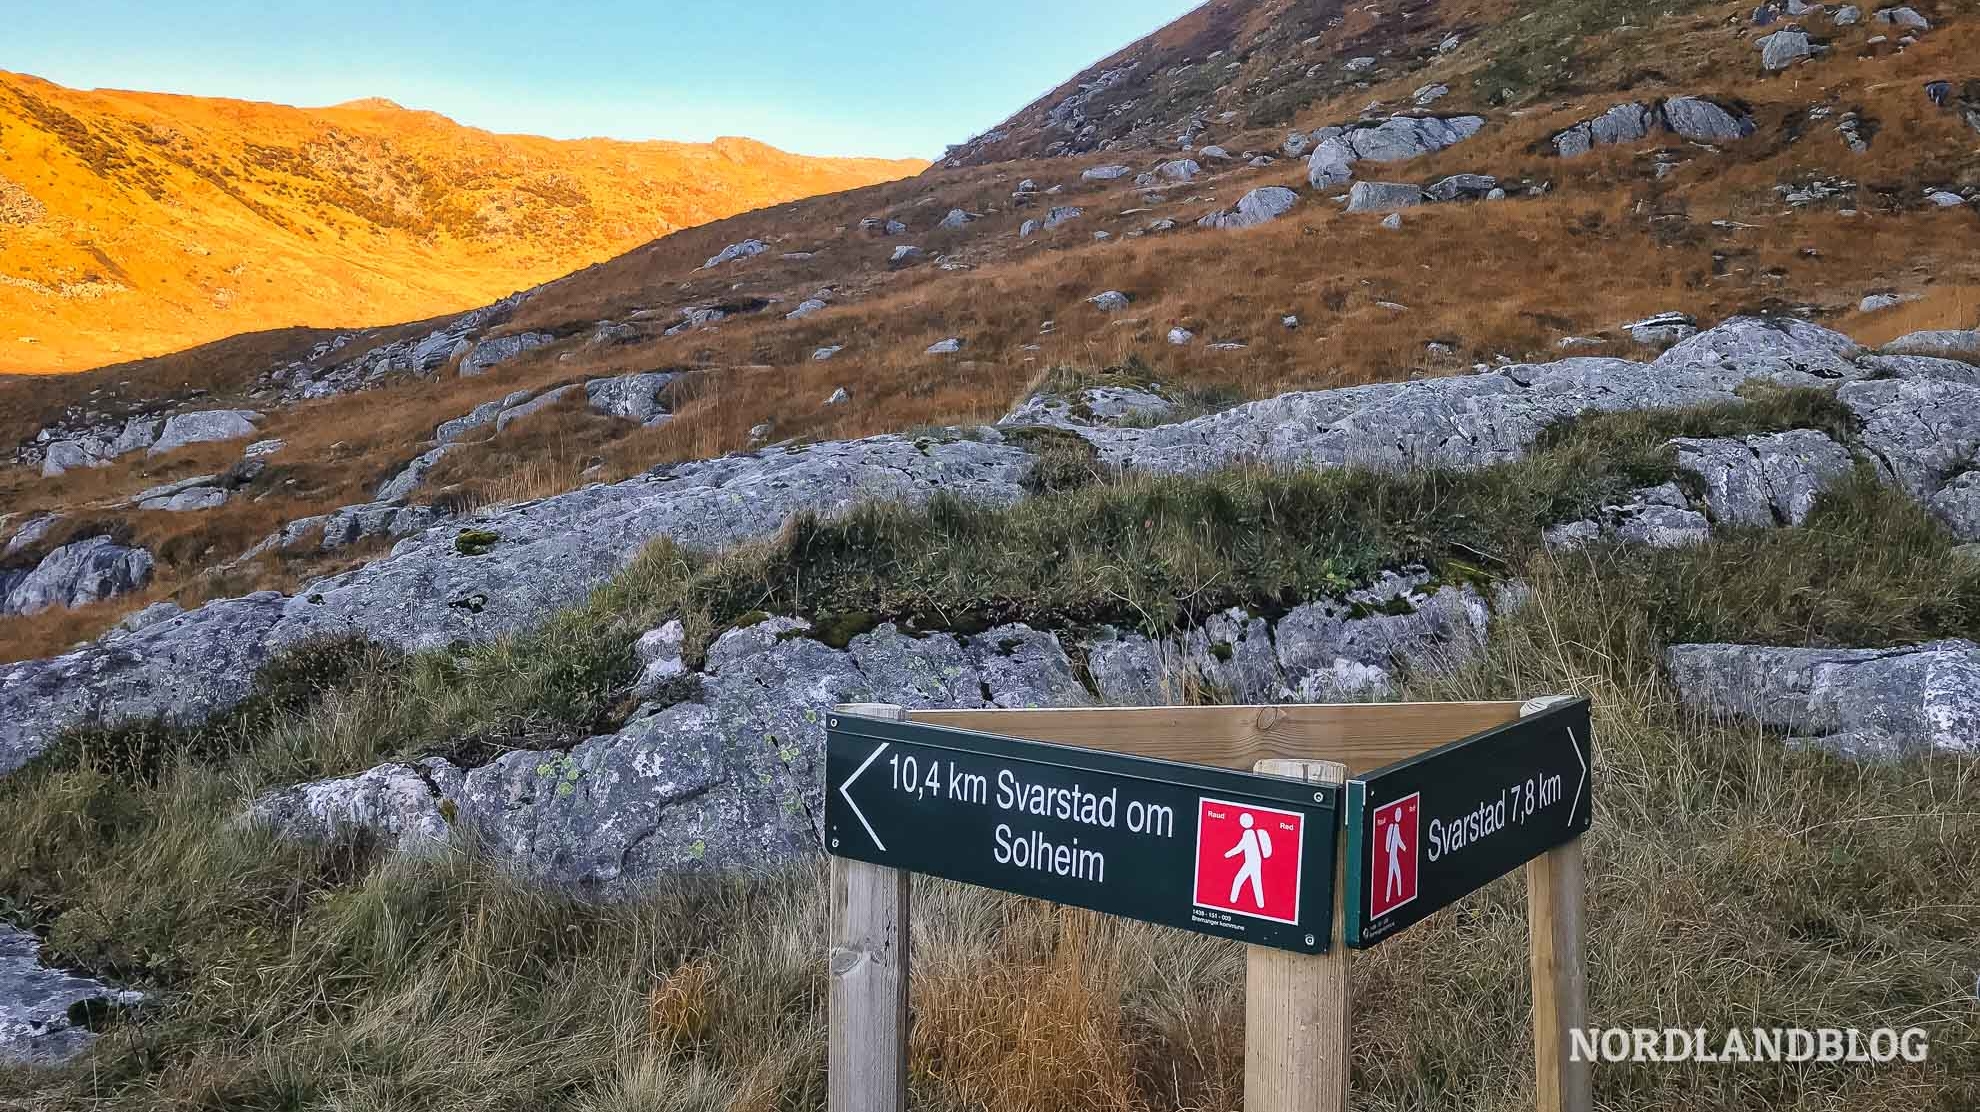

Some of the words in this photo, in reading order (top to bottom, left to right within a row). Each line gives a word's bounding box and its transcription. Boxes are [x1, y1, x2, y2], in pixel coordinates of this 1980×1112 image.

[890, 753, 941, 801] 10,4
[949, 761, 987, 805] km
[996, 769, 1117, 828] Svarstad
[1126, 800, 1173, 838] om
[1207, 810, 1225, 819] Raud
[1428, 789, 1505, 862] Svarstad
[1511, 778, 1535, 825] 7,8
[1539, 773, 1561, 809] km
[993, 823, 1104, 883] Solheim
[1279, 822, 1294, 831] Red
